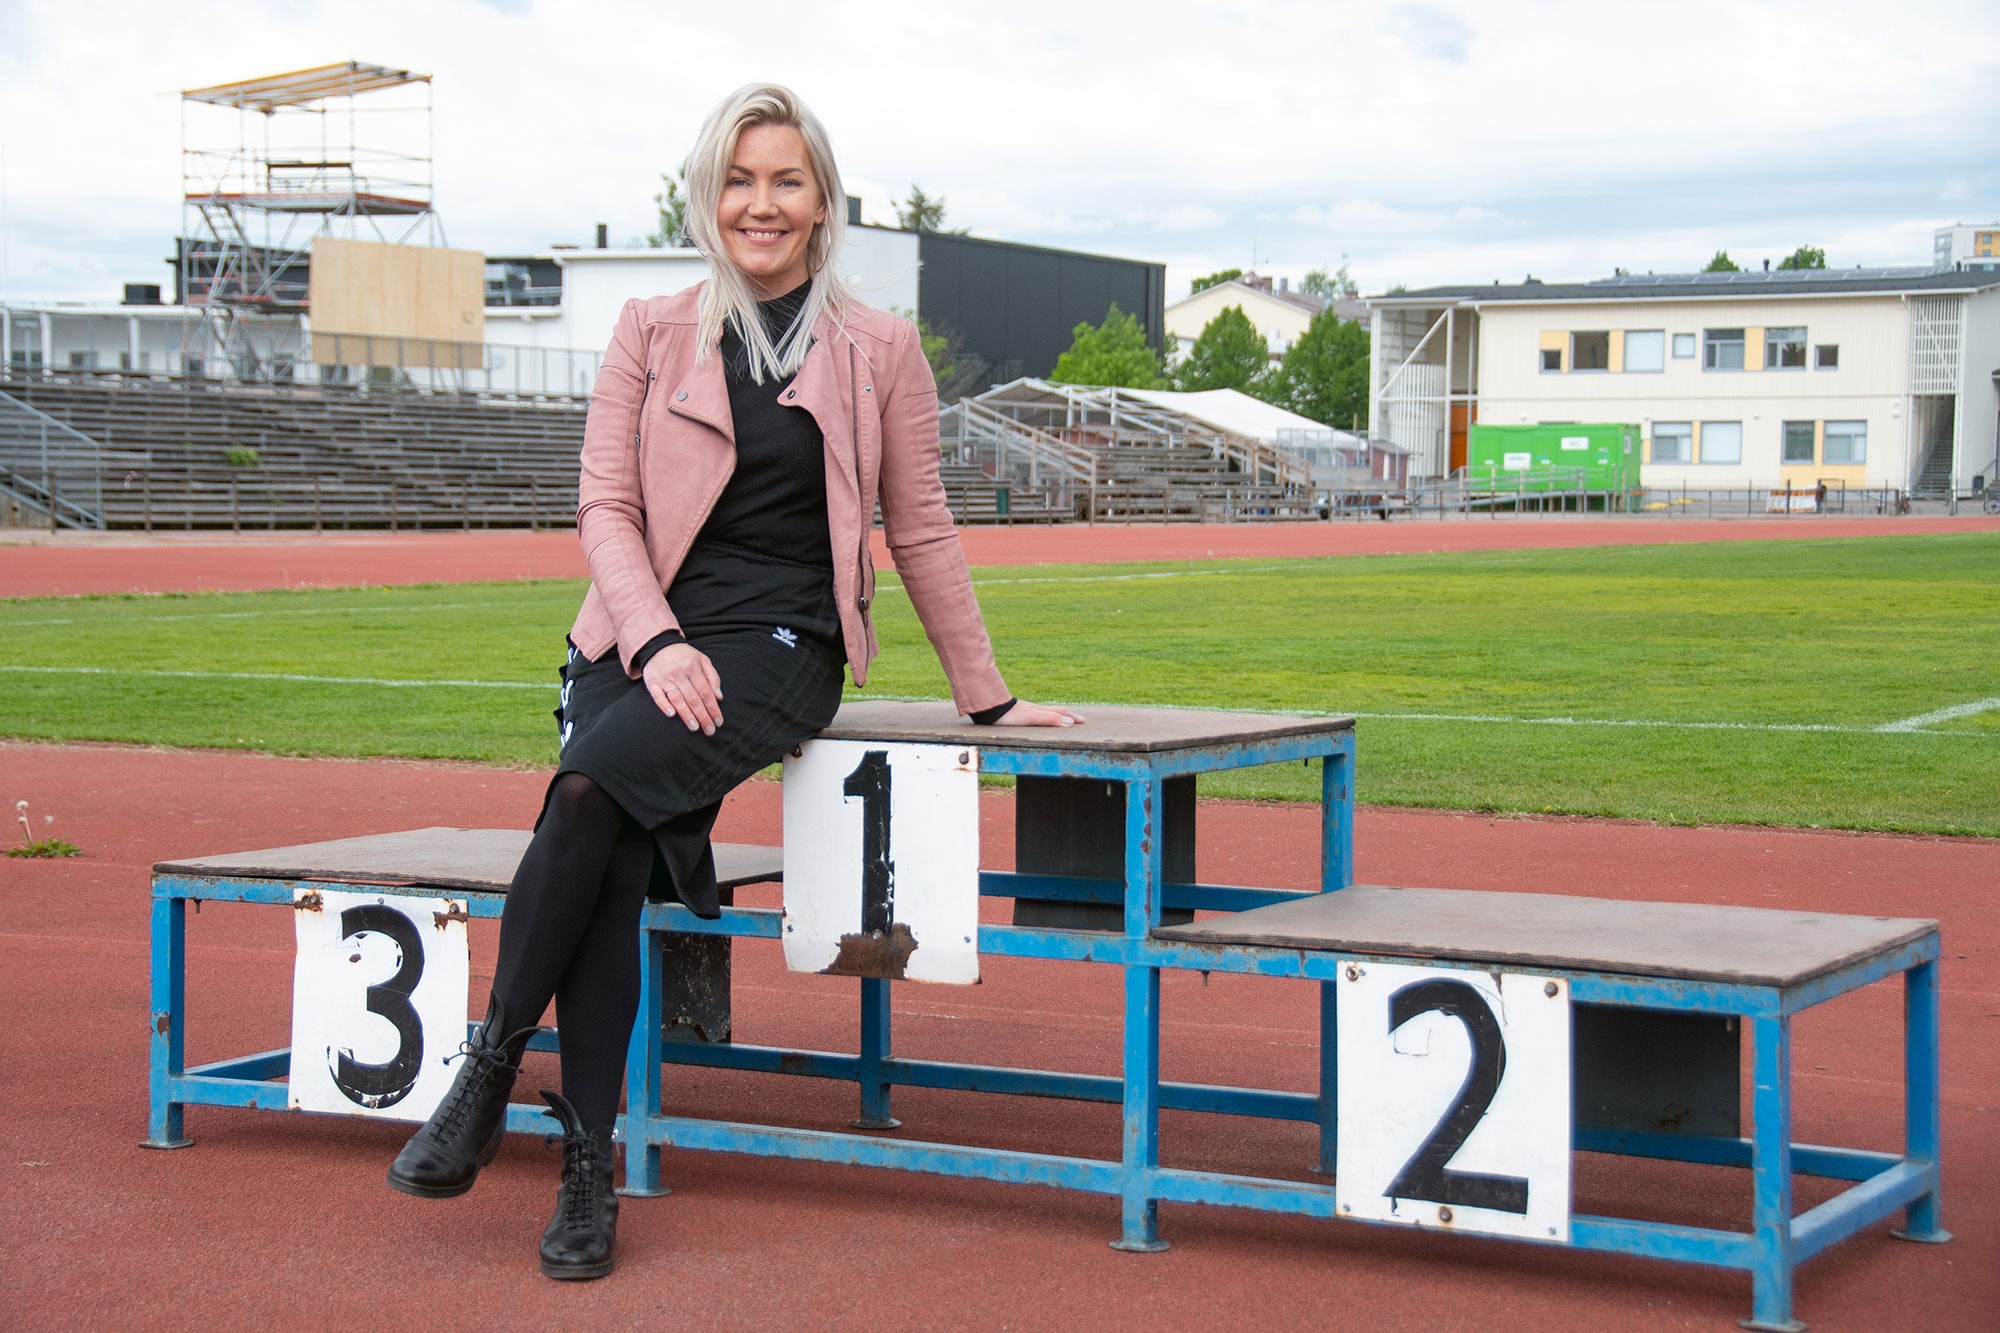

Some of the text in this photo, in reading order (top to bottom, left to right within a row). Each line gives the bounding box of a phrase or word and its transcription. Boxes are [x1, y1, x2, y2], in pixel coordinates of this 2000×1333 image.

[844, 751, 894, 937] 1
[327, 904, 425, 1109] 3
[1382, 977, 1528, 1214] 2
